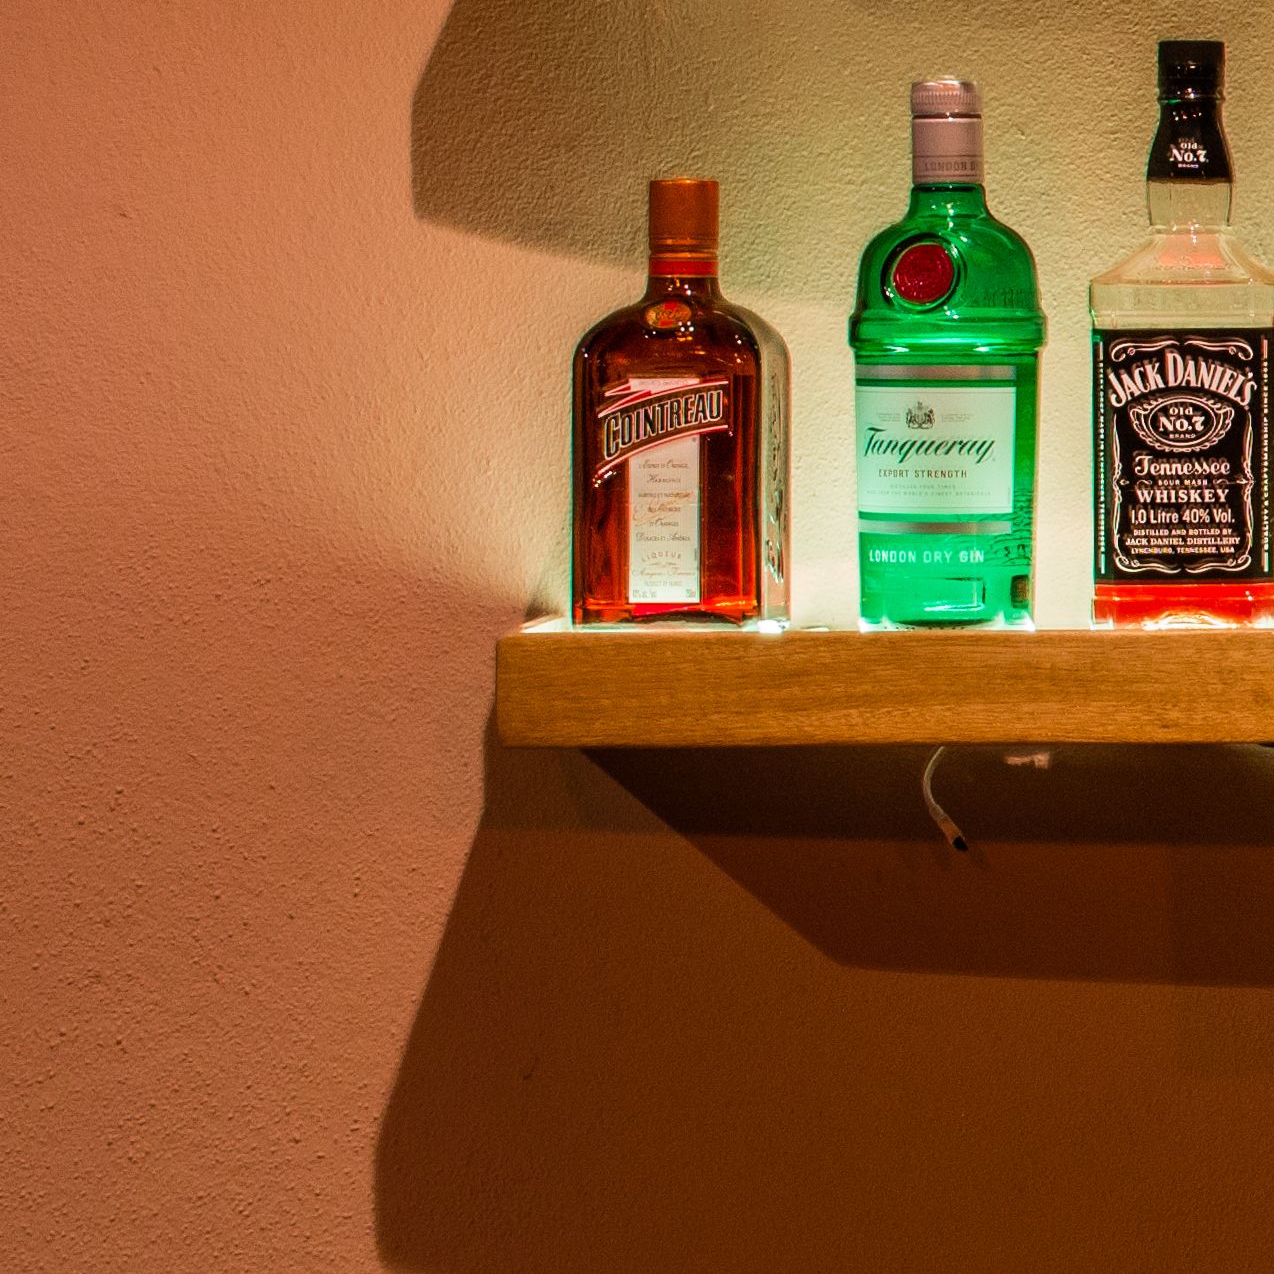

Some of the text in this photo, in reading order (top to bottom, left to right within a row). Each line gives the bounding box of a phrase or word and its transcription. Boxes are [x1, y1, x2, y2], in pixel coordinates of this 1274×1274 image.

[1180, 142, 1198, 150] Old
[1107, 348, 1258, 409] JACK DANIEL'S
[1261, 386, 1271, 414] SINCE
[1168, 406, 1194, 417] Old
[604, 389, 723, 461] COINTREAU
[863, 425, 997, 465] Tanqueray
[1134, 453, 1231, 476] Tennessee
[1261, 416, 1271, 498] CRAFTSMANSHIP
[878, 468, 967, 479] EXPORT STRENGTH
[1135, 488, 1230, 504] WHISKEY
[1149, 508, 1180, 524] Litre
[1181, 508, 1211, 524] 40%
[1212, 507, 1237, 524] Vol.
[1133, 528, 1233, 536] DISTILLED AND BOTTLED BY
[1261, 508, 1271, 551] QUALITY
[1125, 537, 1241, 546] JACK DANIEL DISTILLERY
[868, 548, 985, 564] LONDON DRY GIN
[1220, 546, 1236, 555] USA
